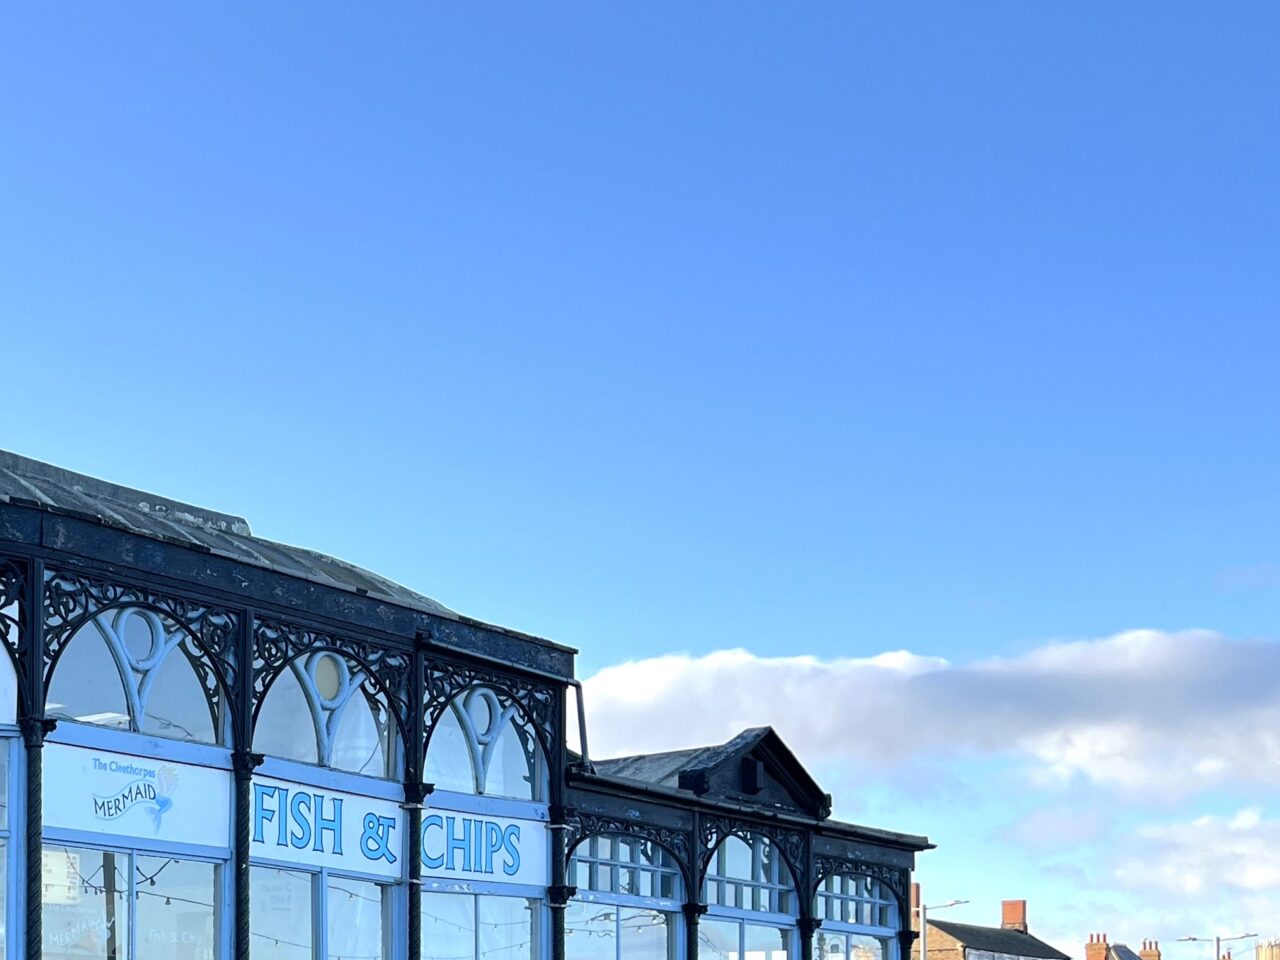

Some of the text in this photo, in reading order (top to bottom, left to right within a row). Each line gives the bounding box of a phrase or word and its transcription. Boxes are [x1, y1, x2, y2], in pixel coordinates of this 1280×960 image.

[92, 758, 156, 779] The Cleethorpes
[93, 783, 157, 817] MERMAID
[253, 783, 521, 876] FISH & CHIPS
